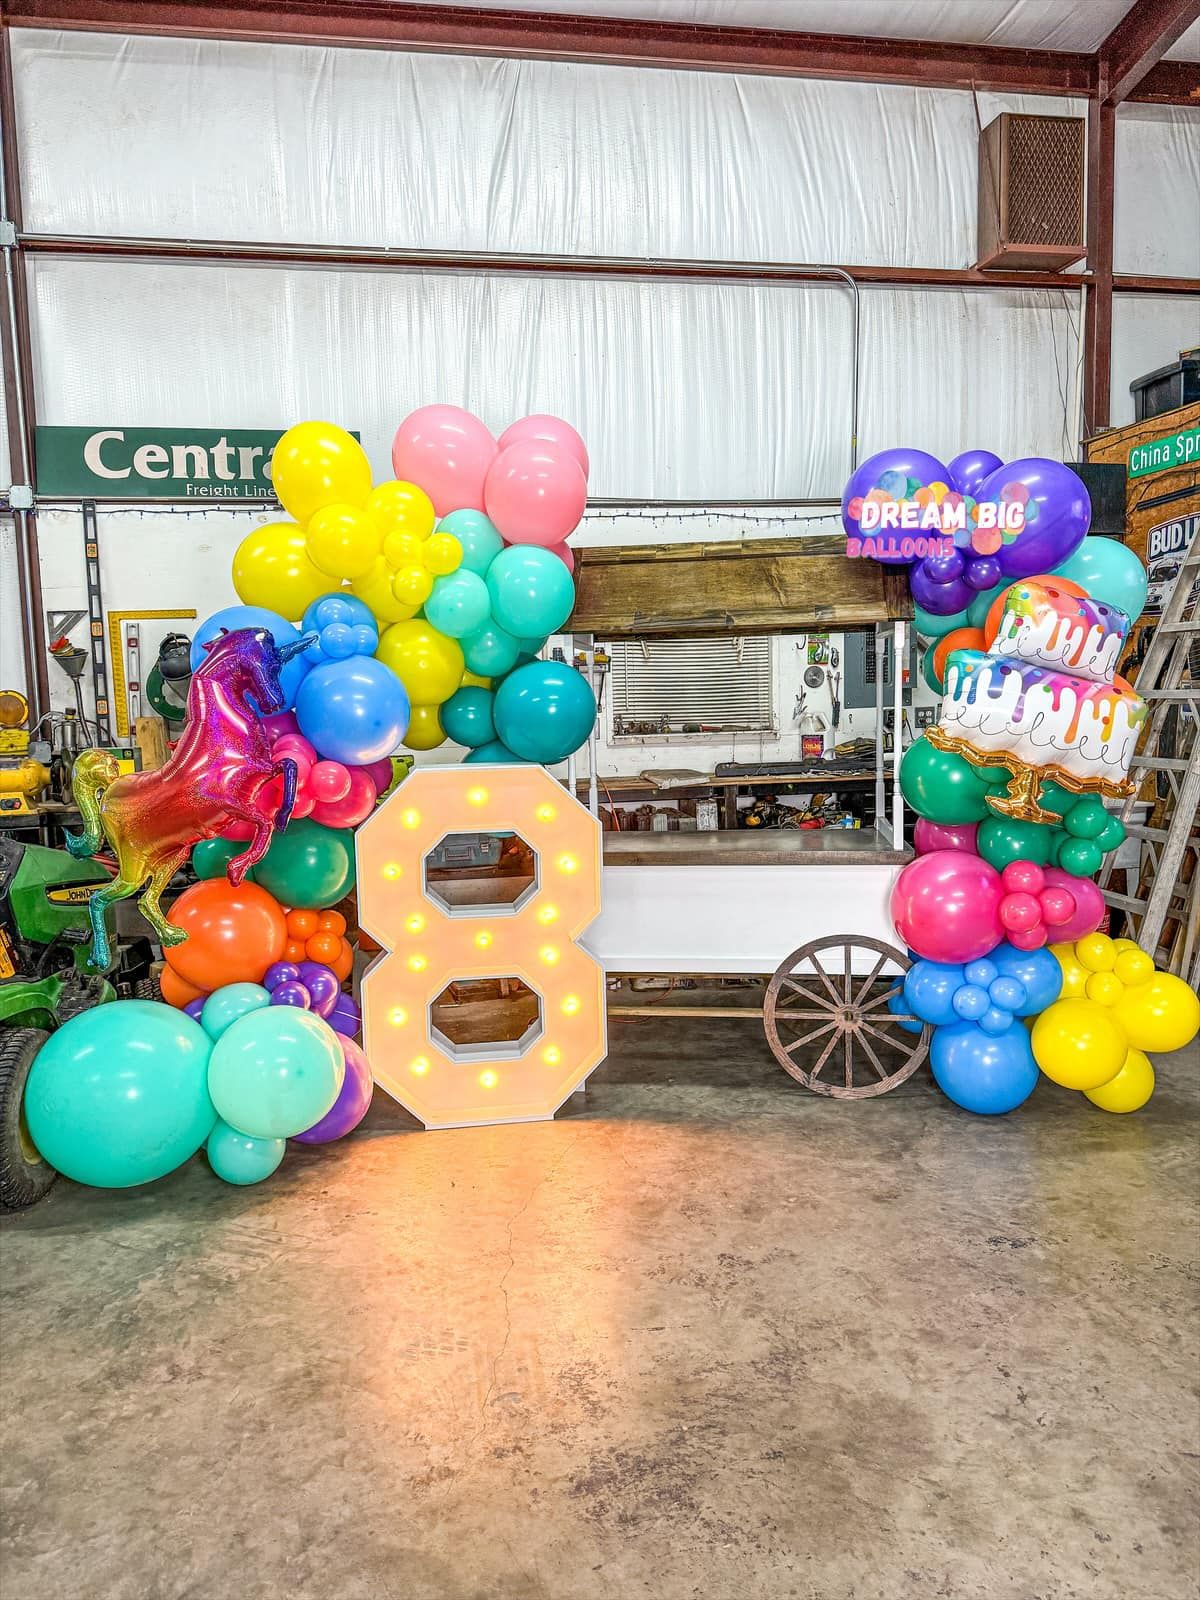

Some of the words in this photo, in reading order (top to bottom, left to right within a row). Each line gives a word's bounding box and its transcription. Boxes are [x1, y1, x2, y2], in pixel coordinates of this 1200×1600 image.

[1131, 444, 1170, 471] China
[186, 483, 239, 497] Freight
[1150, 523, 1183, 557] BUD
[67, 887, 86, 900] JOHN
[355, 763, 608, 1131] 8
